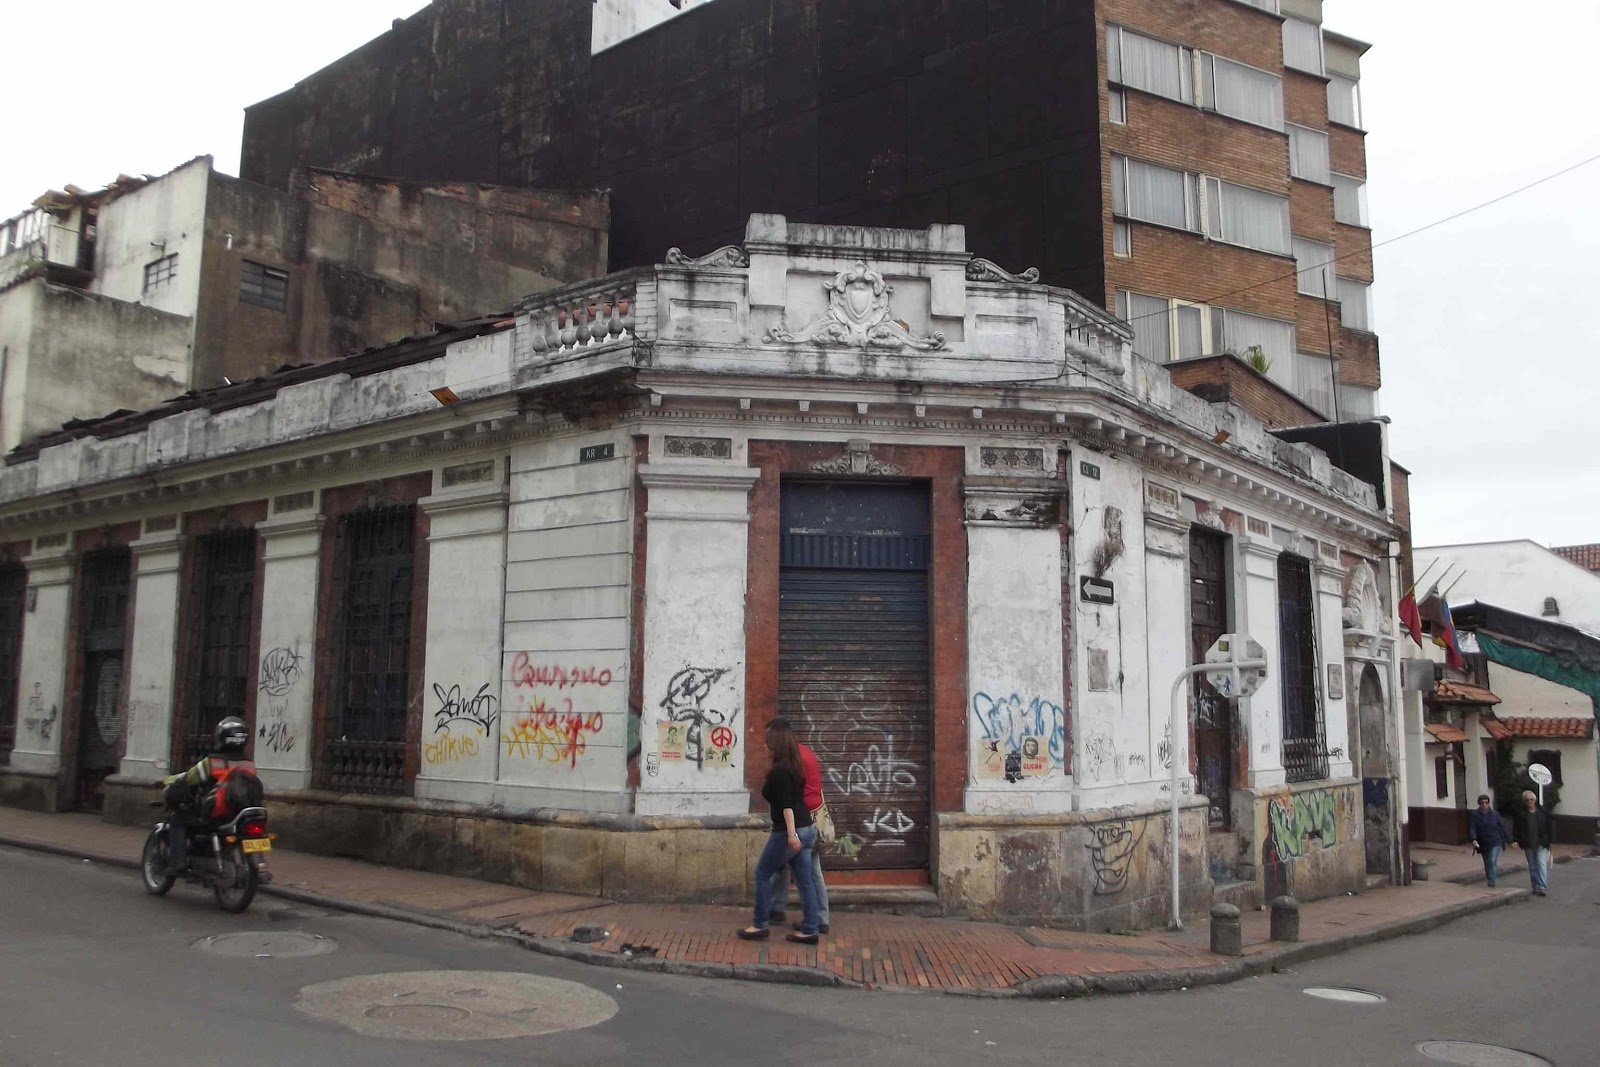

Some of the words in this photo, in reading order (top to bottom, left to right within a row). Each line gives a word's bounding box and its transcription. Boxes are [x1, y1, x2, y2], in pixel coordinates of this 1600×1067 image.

[586, 448, 595, 459] KR
[603, 446, 608, 456] 4
[1082, 463, 1089, 475] CL
[1092, 467, 1098, 477] 12
